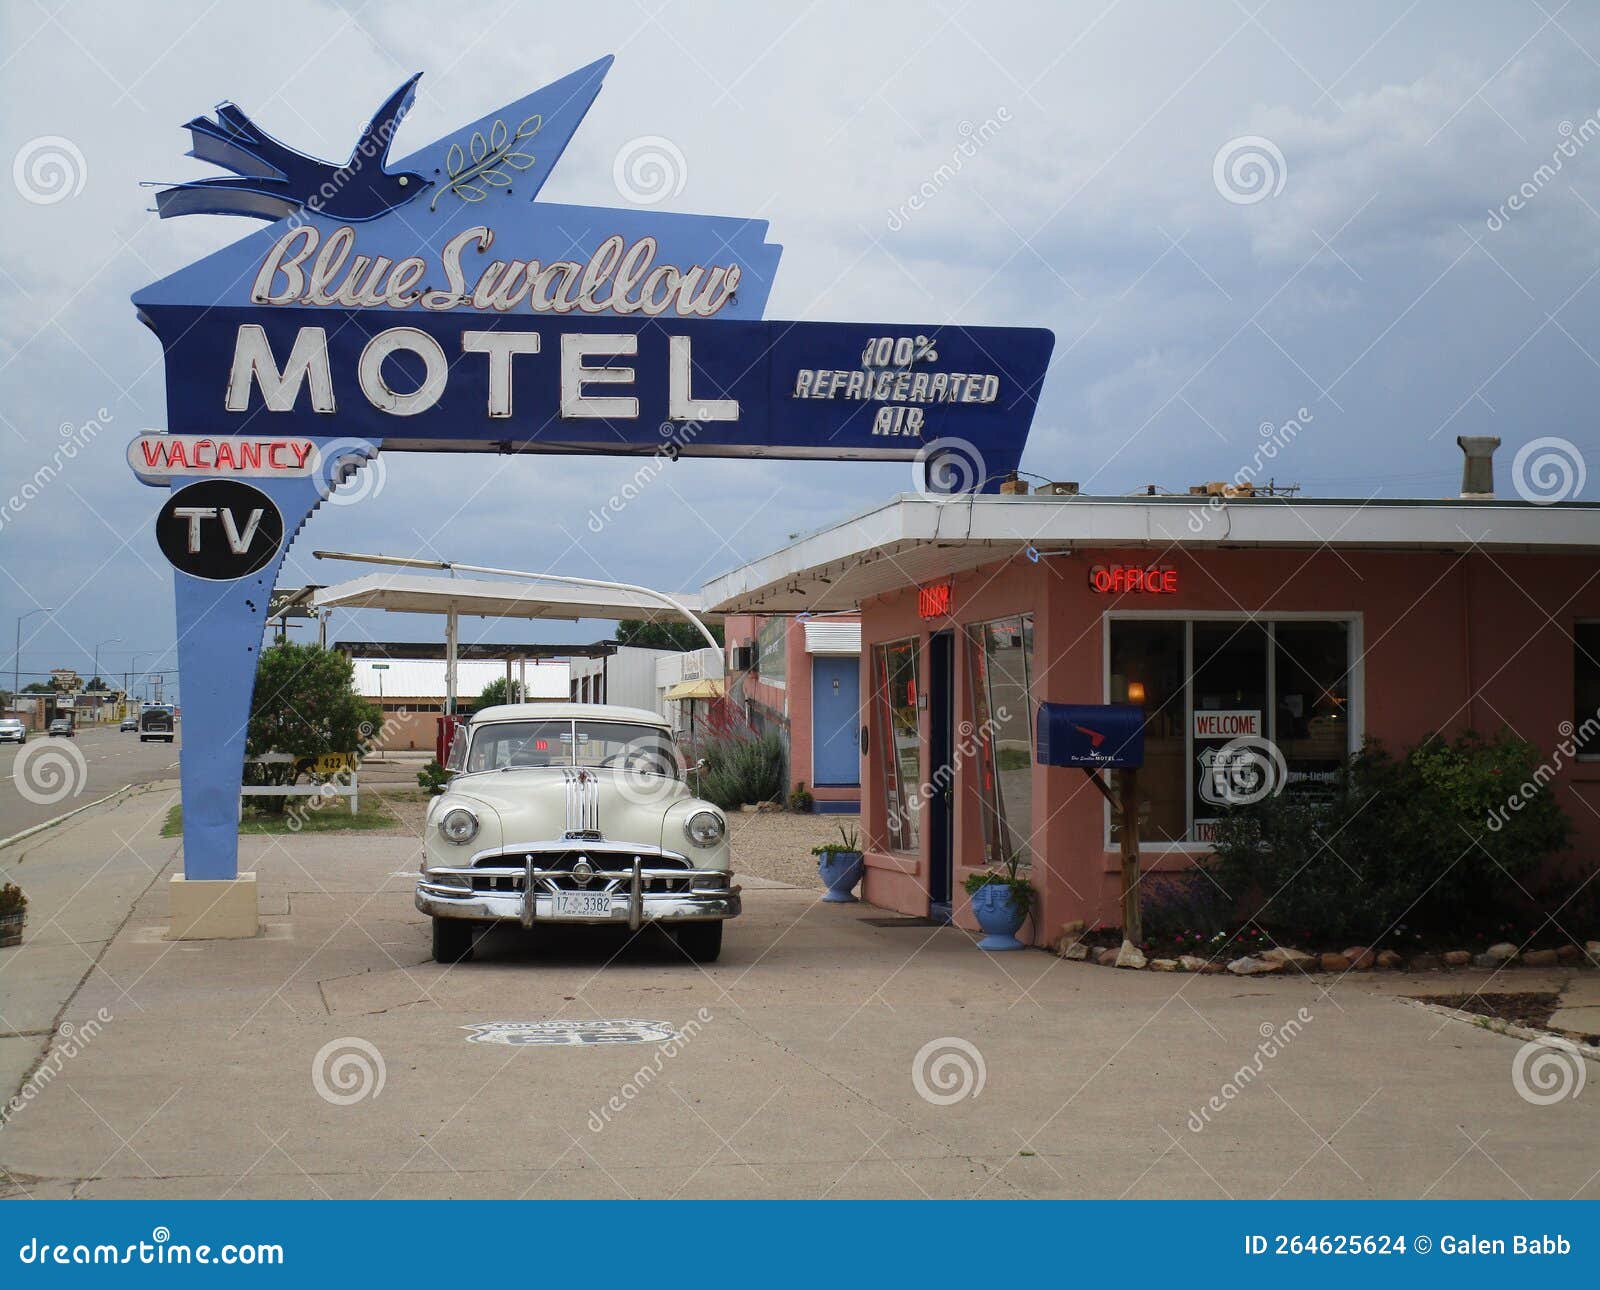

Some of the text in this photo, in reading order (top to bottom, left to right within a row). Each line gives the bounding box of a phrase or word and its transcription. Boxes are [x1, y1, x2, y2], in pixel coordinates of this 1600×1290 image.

[249, 225, 742, 318] Blue Swallow
[862, 335, 939, 367] 100%
[224, 324, 740, 420] MOTEL
[792, 369, 1000, 403] REFRIGERATED
[872, 406, 925, 436] AIR
[140, 439, 313, 470] VACANCY
[172, 506, 265, 555] TV
[1093, 566, 1177, 593] OFFICE
[1197, 715, 1257, 735] WELCOME
[1210, 754, 1246, 765] ROUTE
[557, 896, 610, 912] 17 3382
